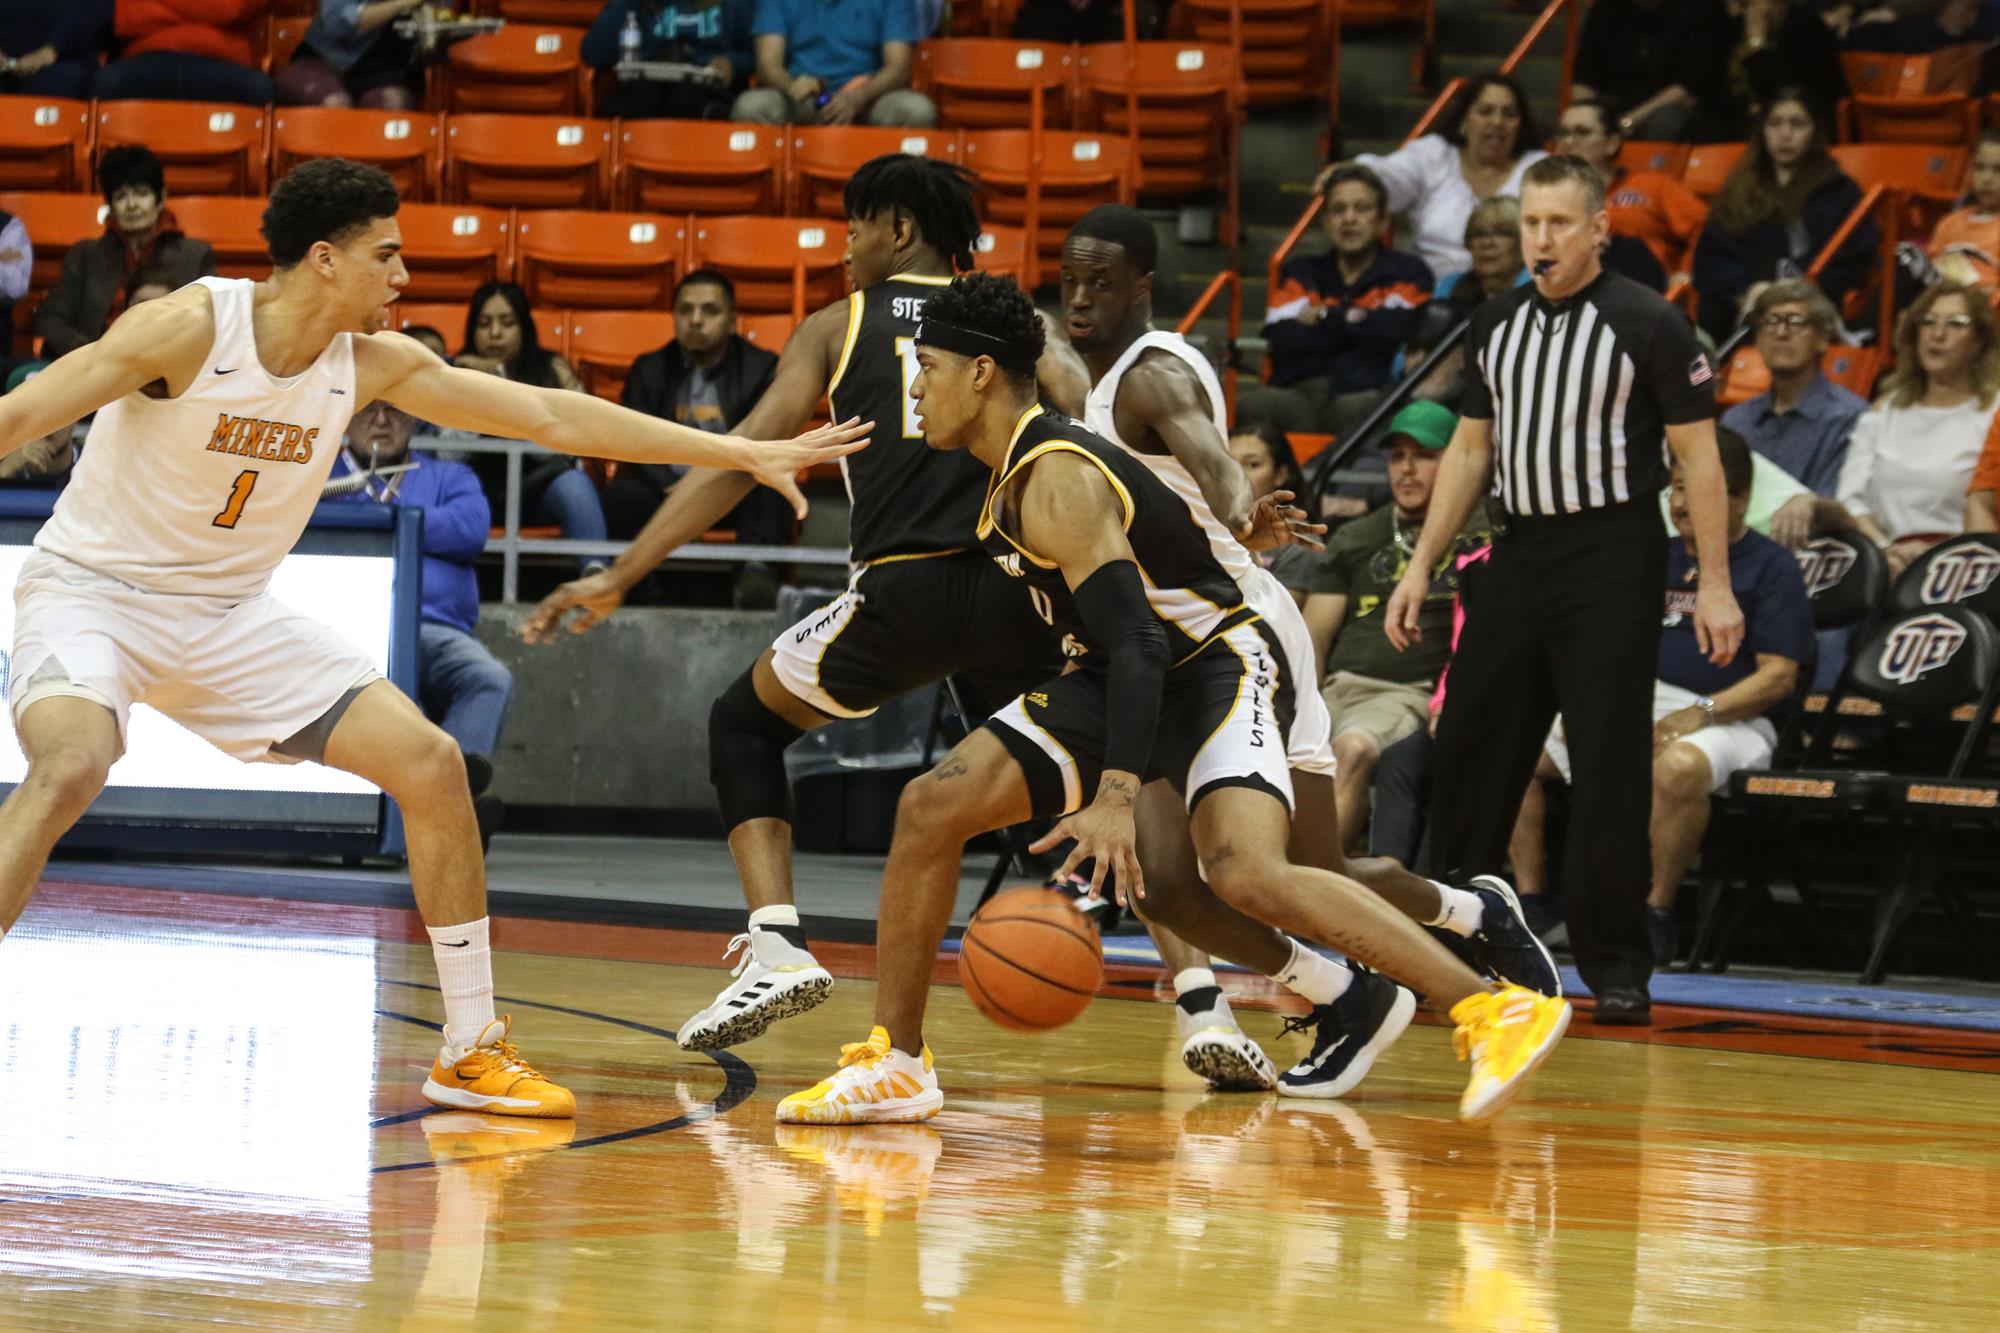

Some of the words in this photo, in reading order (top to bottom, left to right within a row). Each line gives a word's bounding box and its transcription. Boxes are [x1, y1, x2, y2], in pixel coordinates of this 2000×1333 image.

[892, 297, 927, 321] STE
[206, 413, 319, 464] MINERS
[212, 469, 259, 529] 1
[796, 601, 849, 643] LES
[1907, 785, 1999, 807] MINERS
